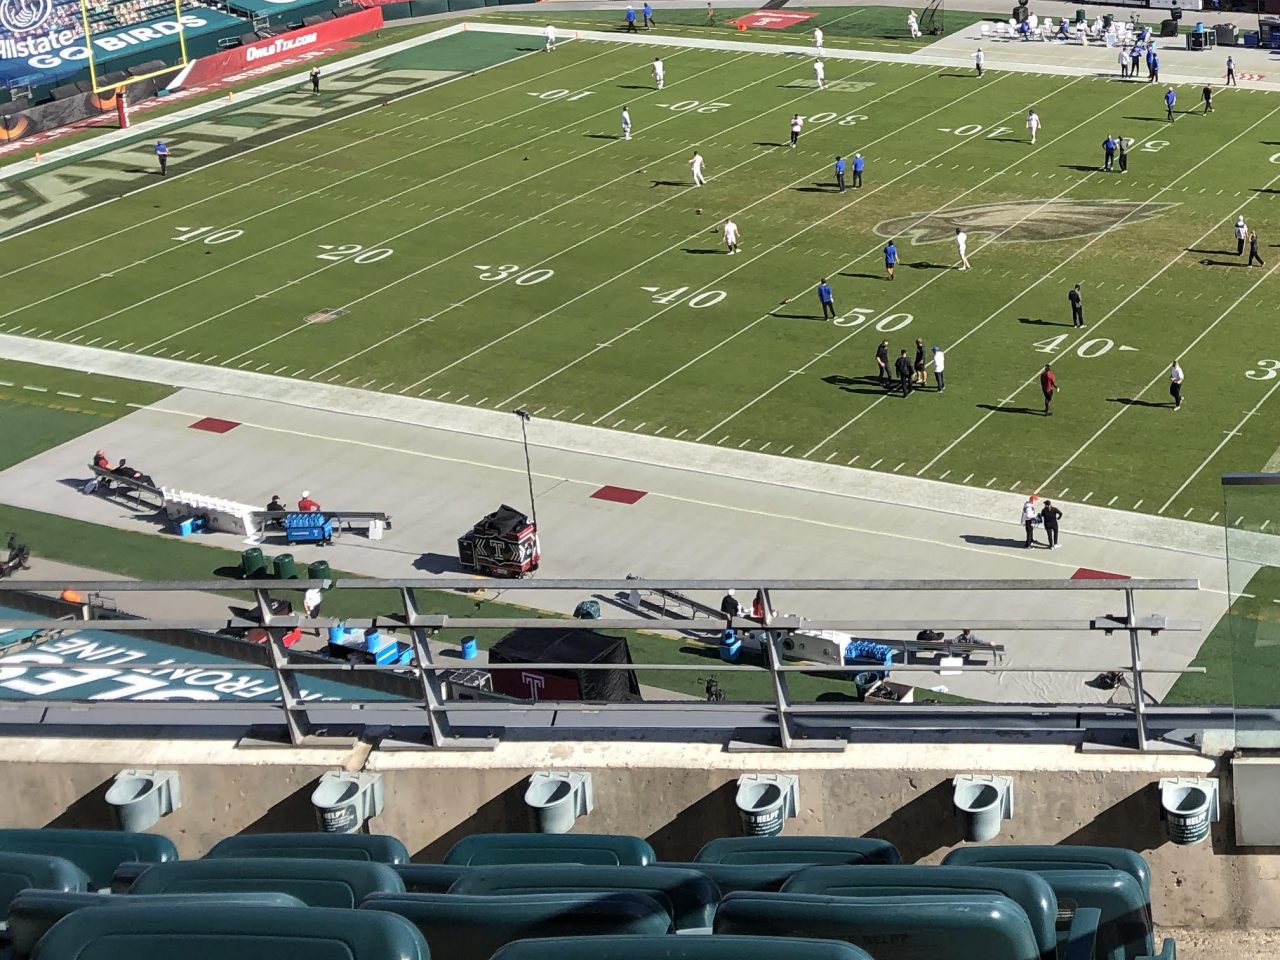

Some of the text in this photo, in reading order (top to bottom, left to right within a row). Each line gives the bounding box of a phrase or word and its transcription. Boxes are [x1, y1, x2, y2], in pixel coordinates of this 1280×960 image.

[28, 15, 207, 69] GO BIRDS
[171, 226, 244, 244] 10
[316, 244, 393, 263] 20
[479, 264, 554, 285] 30
[652, 286, 727, 308] 40
[833, 307, 914, 332] 50
[1032, 333, 1114, 358] 40
[38, 639, 148, 665] LINE
